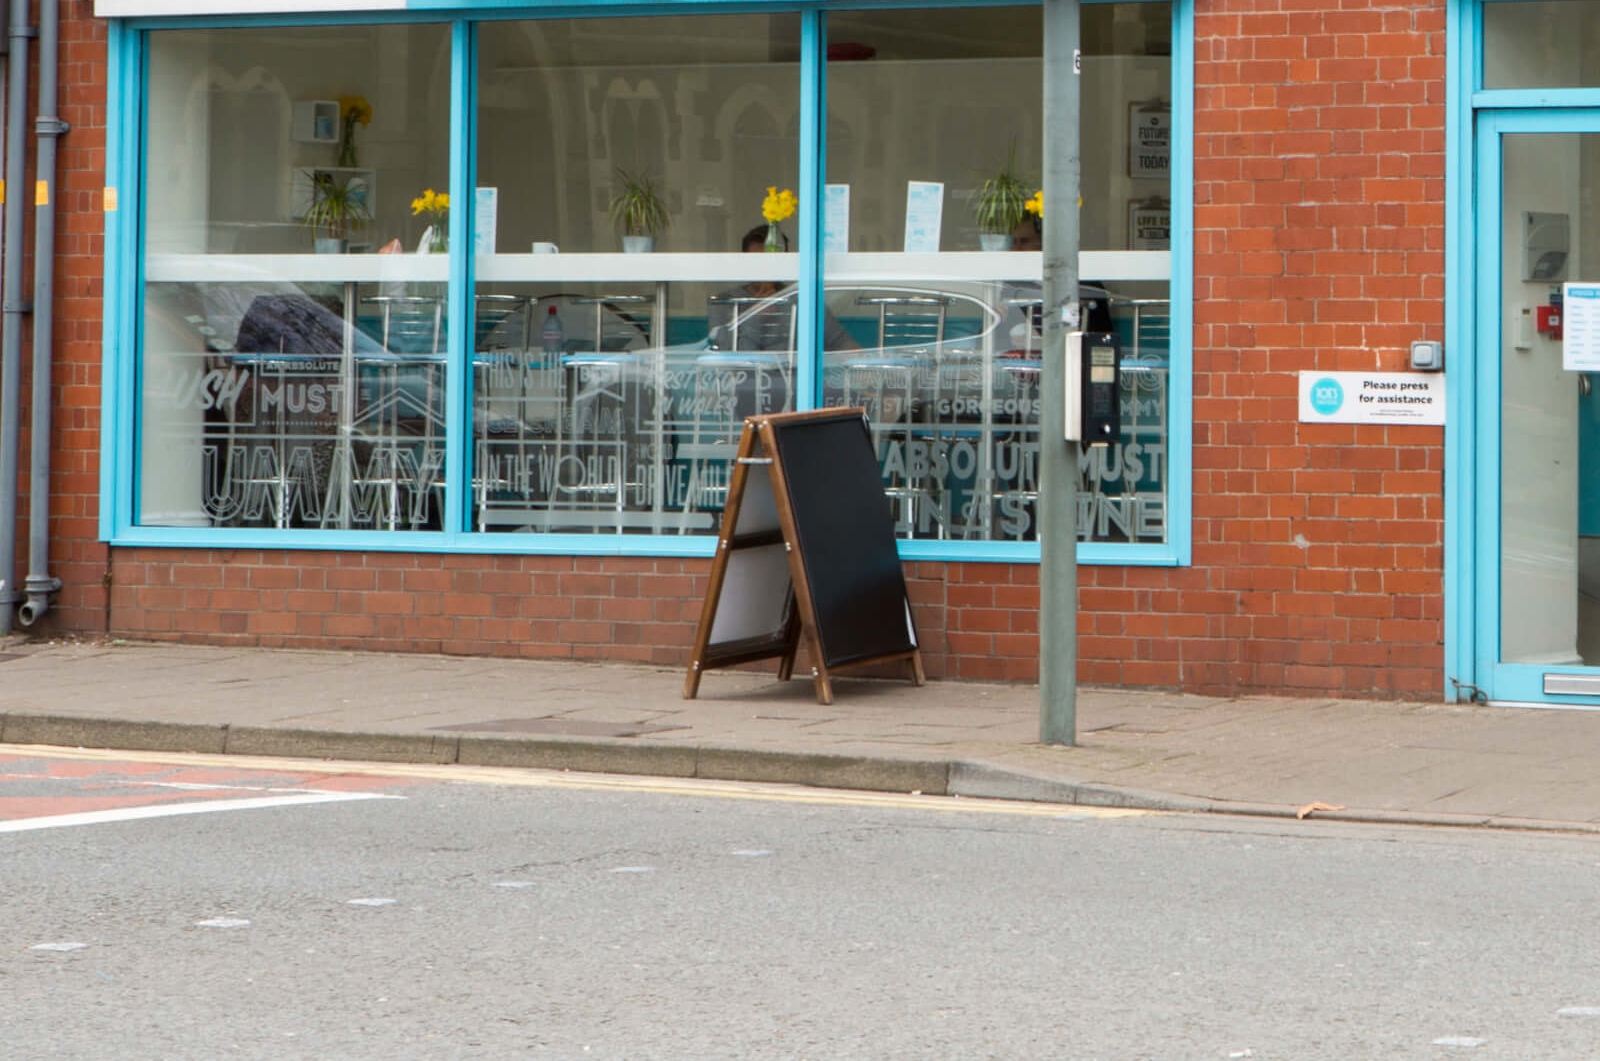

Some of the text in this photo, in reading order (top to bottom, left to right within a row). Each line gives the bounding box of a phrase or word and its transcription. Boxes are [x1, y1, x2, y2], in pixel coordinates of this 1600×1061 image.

[702, 370, 748, 389] STOP
[1363, 380, 1429, 392] Please press
[261, 383, 343, 414] MUST
[937, 399, 1042, 416] GORGEOUS
[1359, 394, 1433, 405] for assistance
[504, 453, 535, 493] THE
[882, 440, 1166, 483] ABSOLUT MUST
[200, 445, 447, 523] UMMY
[690, 465, 735, 507] MILE
[1000, 489, 1164, 537] SINE
